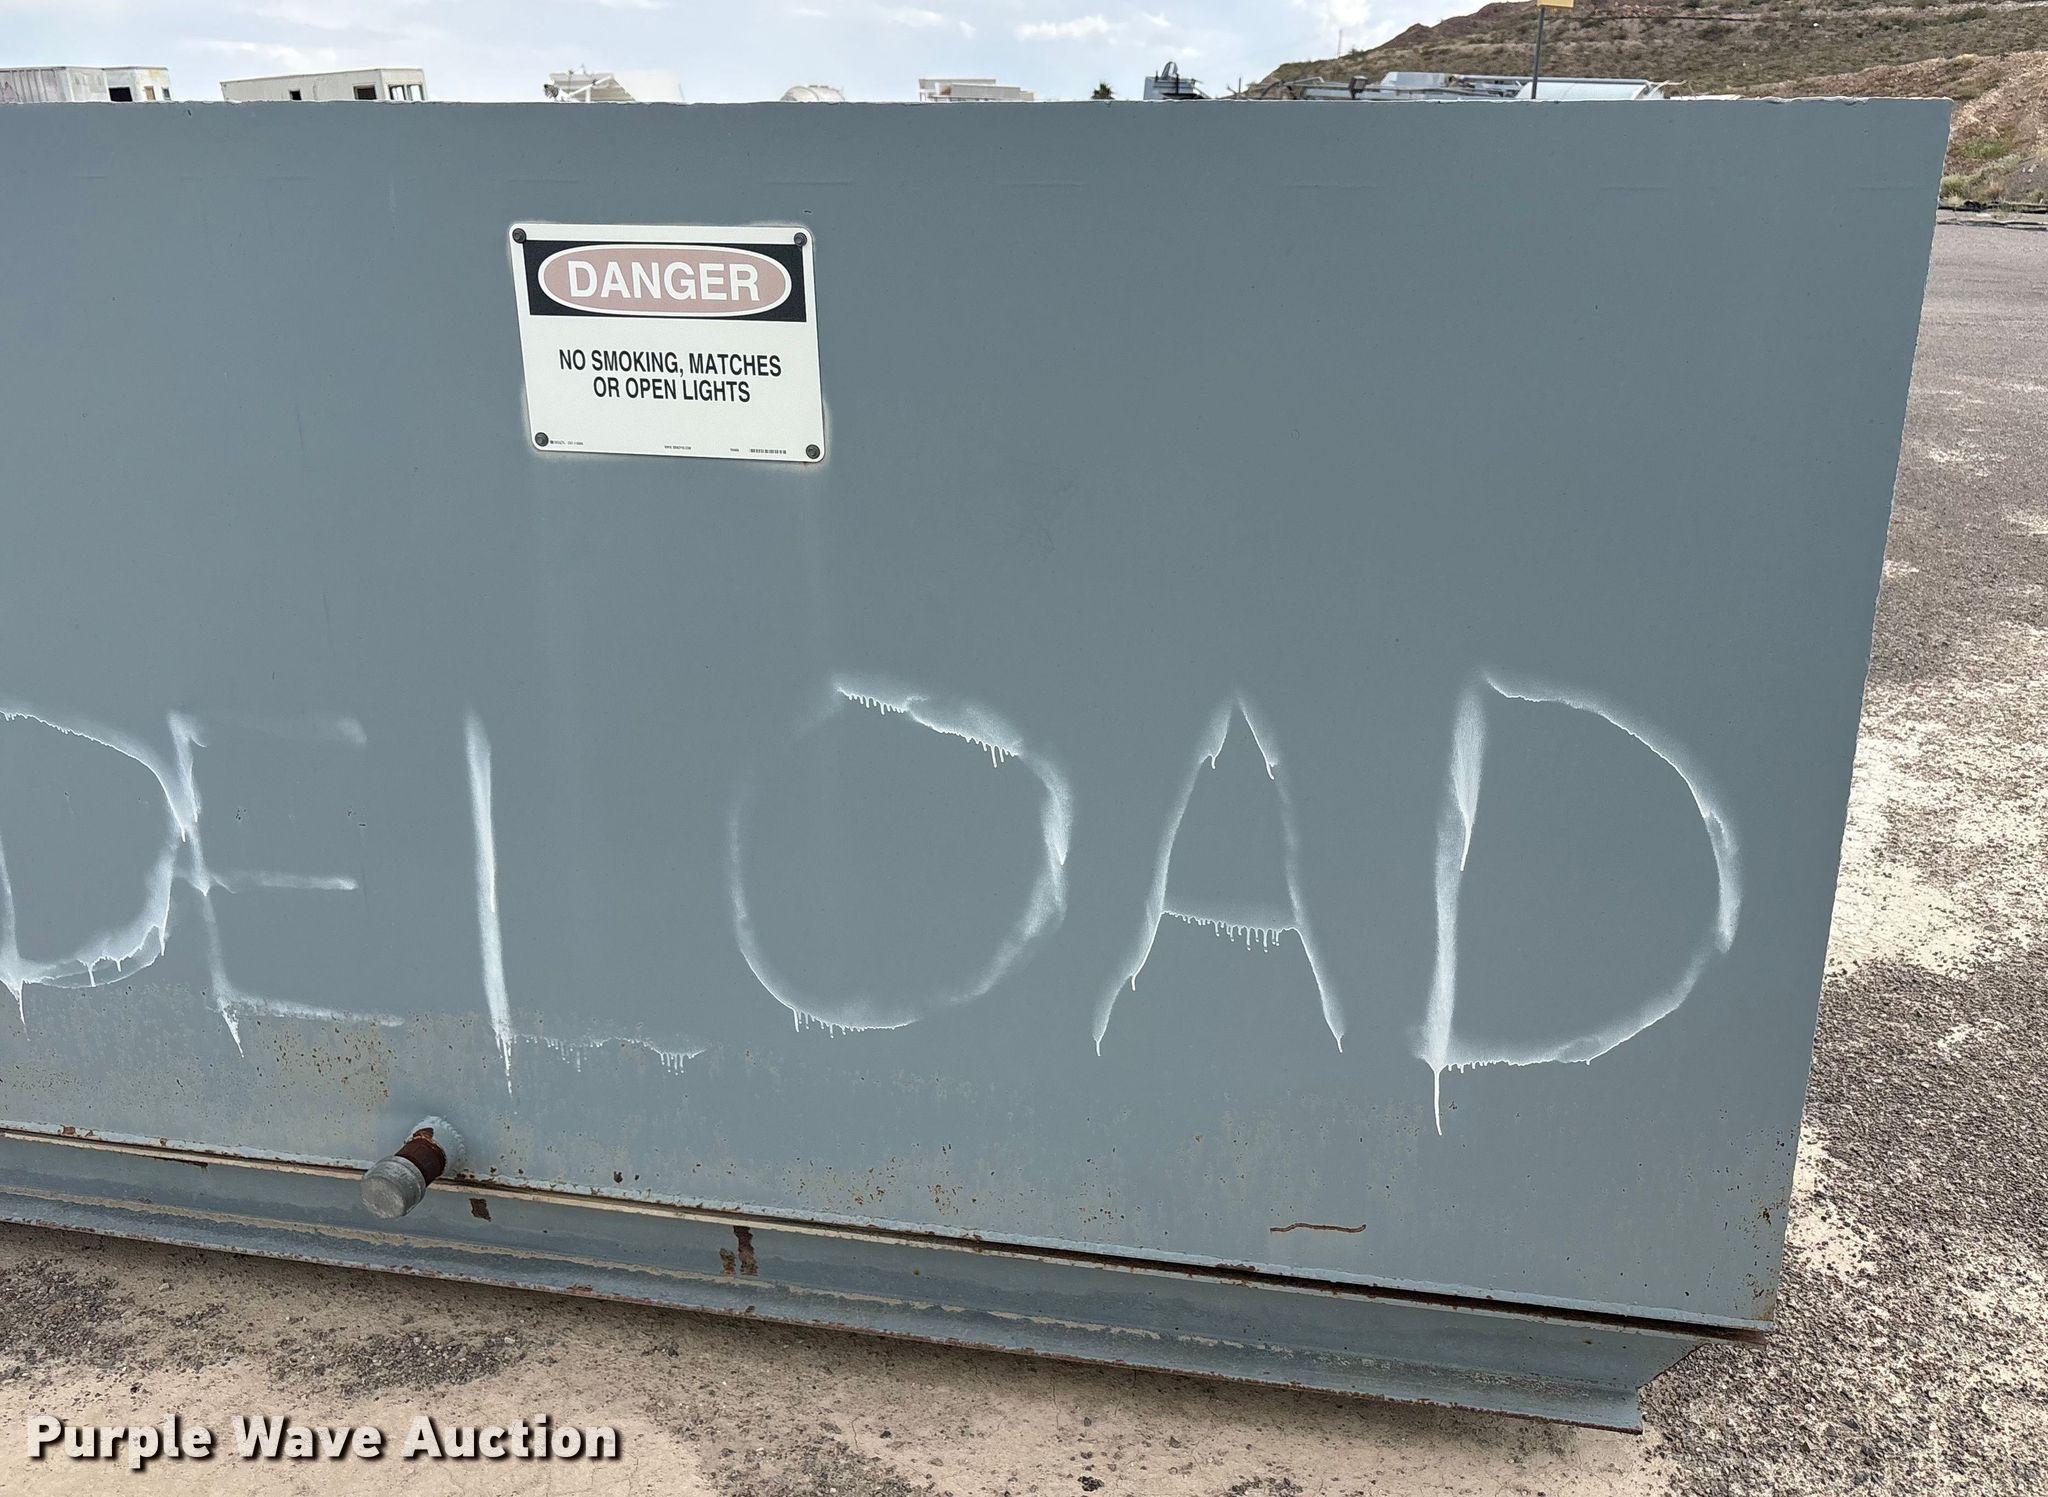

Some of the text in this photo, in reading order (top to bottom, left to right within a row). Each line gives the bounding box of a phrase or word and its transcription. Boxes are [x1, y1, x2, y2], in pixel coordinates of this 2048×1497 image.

[567, 260, 760, 301] DANGER
[559, 349, 782, 377] NO SMOKING, MATCHES
[593, 376, 750, 402] OR OPEN LIGHTS
